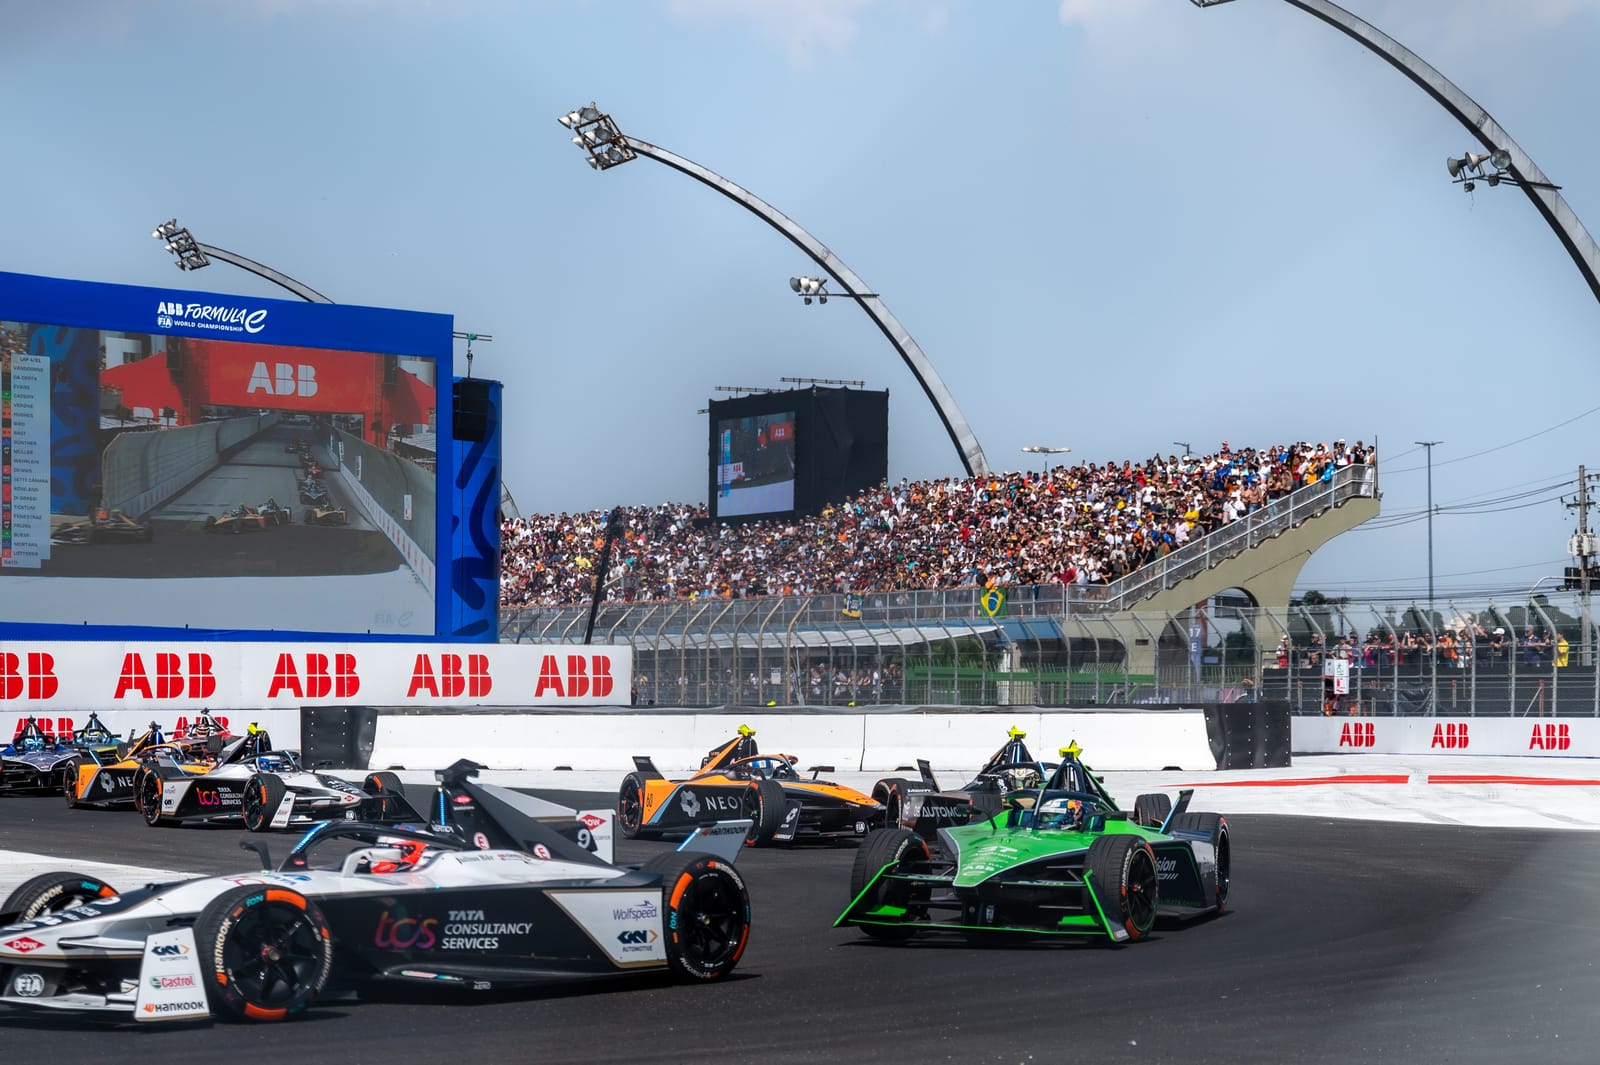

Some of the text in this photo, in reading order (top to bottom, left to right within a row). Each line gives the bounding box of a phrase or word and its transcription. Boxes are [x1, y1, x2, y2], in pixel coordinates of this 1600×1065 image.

[158, 302, 184, 316] ABB
[184, 304, 247, 325] FORMULA
[158, 315, 173, 328] FIA
[198, 323, 243, 332] CHAMPIONSHIP
[247, 362, 318, 397] ABB
[1189, 627, 1201, 638] 17
[0, 653, 613, 699] BB ABB ABB ABB ABB
[1340, 723, 1571, 750] ABB ABB ABB
[196, 787, 220, 806] tcs
[705, 796, 743, 810] NEO
[577, 828, 591, 849] 9
[448, 910, 485, 921] TATA
[613, 906, 657, 922] Wolfspeed
[375, 911, 439, 948] tcs
[444, 923, 533, 935] CONSULTANCY
[441, 938, 499, 949] SERVICES
[161, 976, 194, 988] Castrol
